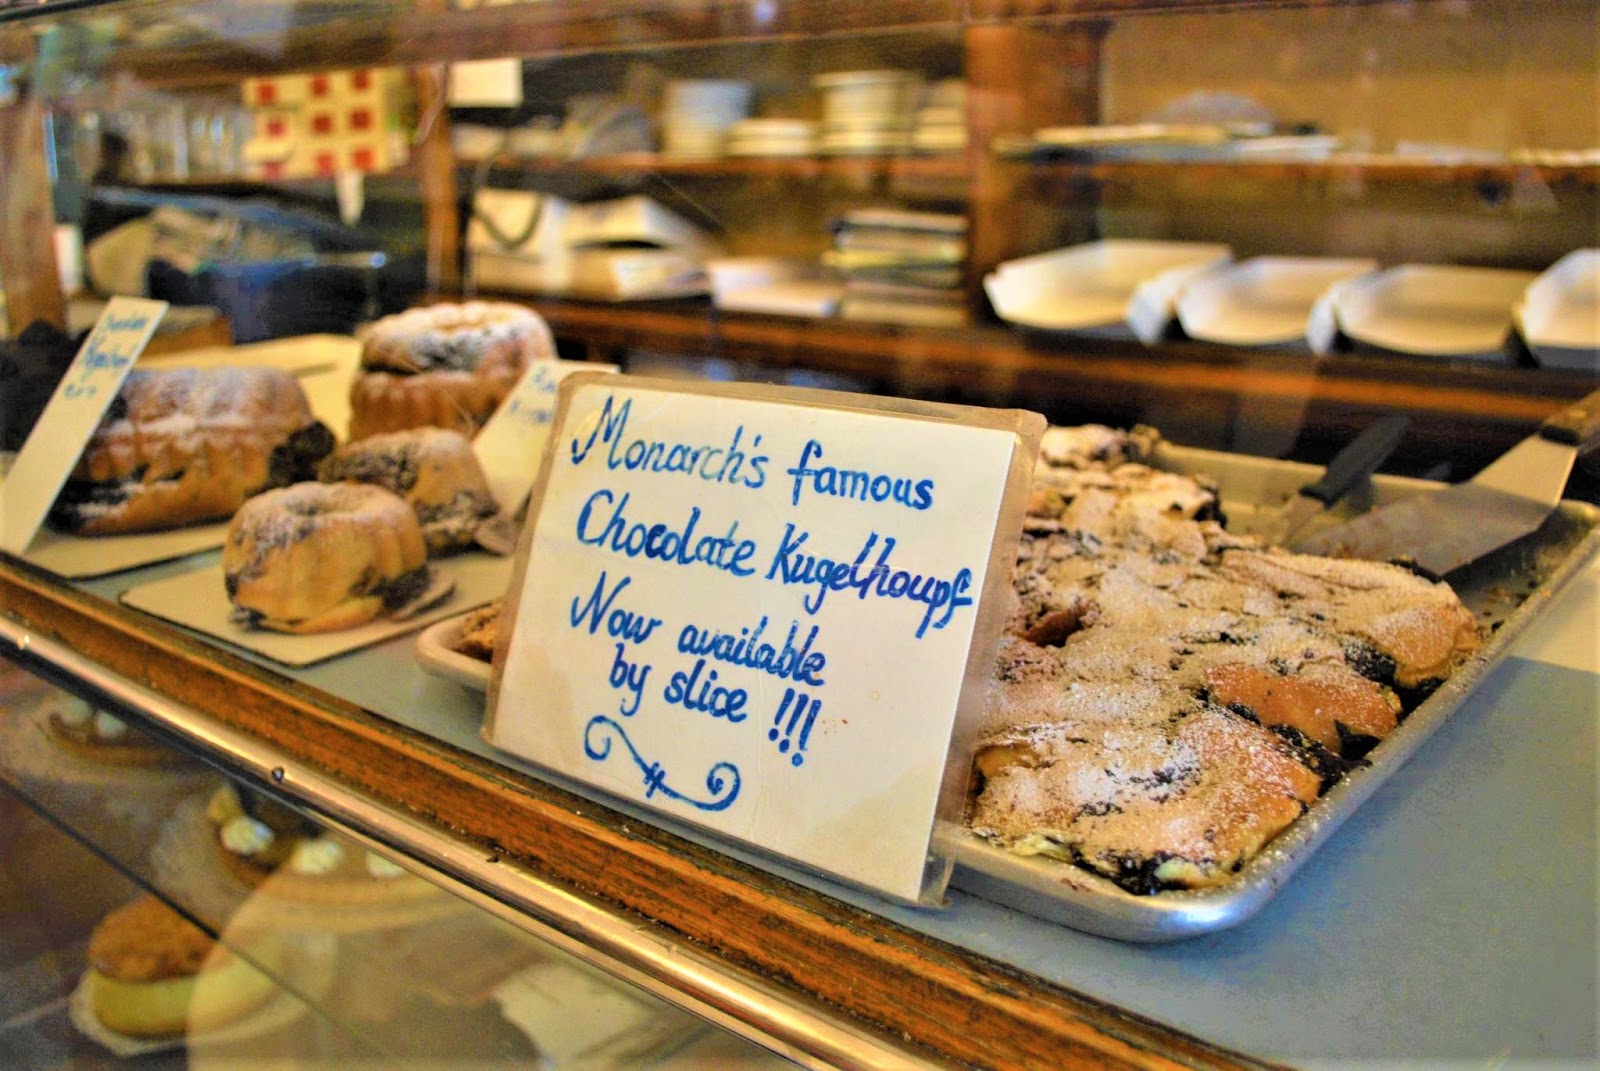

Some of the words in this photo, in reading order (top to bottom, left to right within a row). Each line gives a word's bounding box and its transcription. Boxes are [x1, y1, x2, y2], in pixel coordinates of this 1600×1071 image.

[571, 395, 768, 489] Monarch's
[788, 439, 934, 510] famous
[577, 489, 756, 577] Chocolate
[766, 523, 973, 639] Kugelhoupf
[570, 571, 662, 643] Now
[678, 616, 826, 687] available
[609, 643, 652, 717] by
[664, 659, 748, 722] slice
